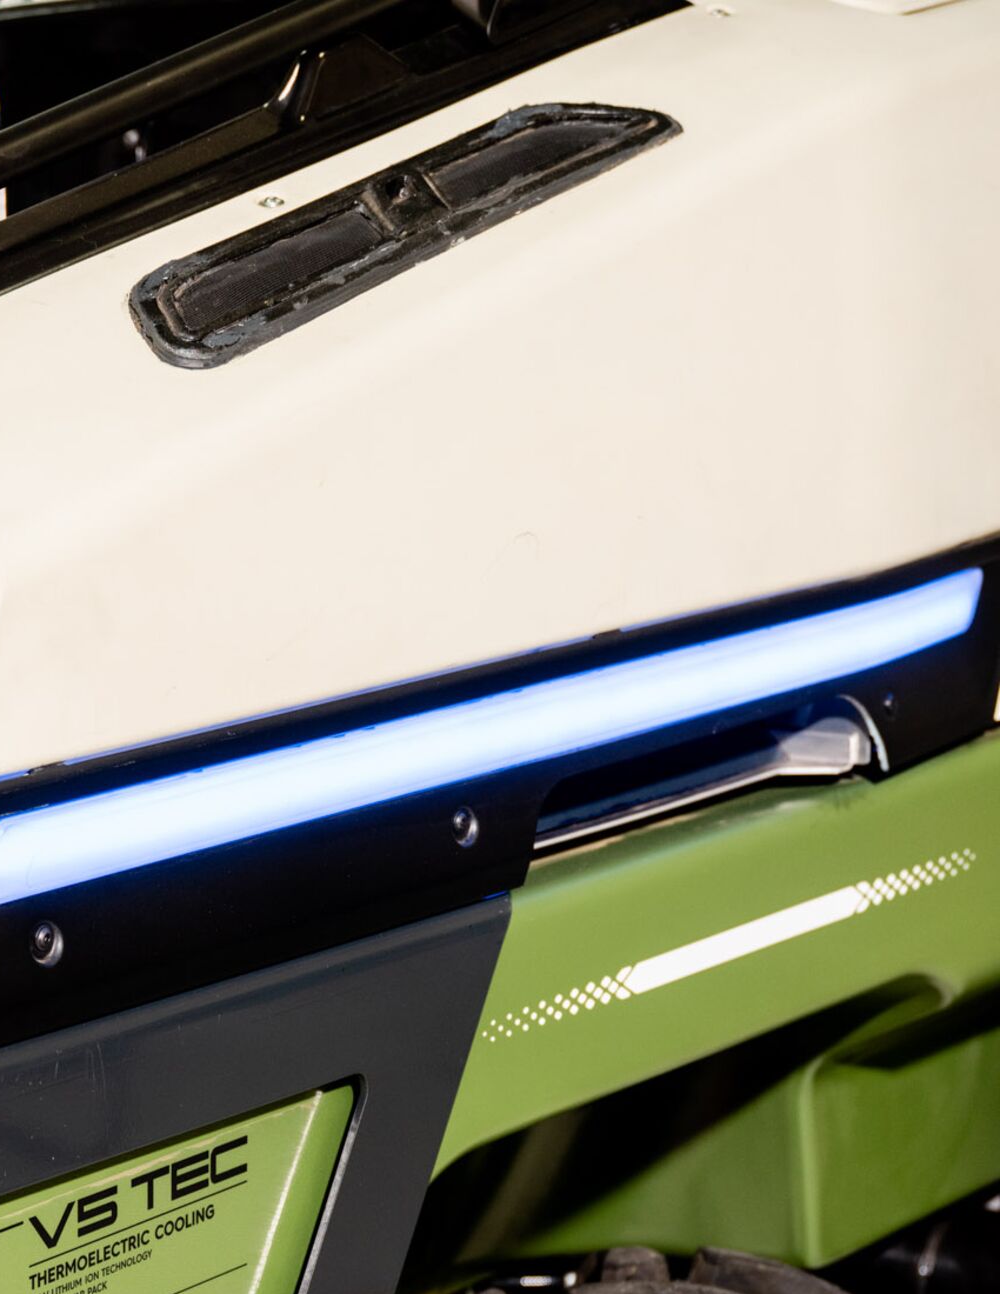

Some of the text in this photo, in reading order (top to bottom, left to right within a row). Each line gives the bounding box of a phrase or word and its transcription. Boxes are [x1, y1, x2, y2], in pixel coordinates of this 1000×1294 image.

[131, 1135, 249, 1210] TEC
[29, 1204, 216, 1290] THERMOELECTRIC COOLING
[84, 1271, 100, 1284] ION
[102, 1249, 152, 1277] TECHNOLOGY
